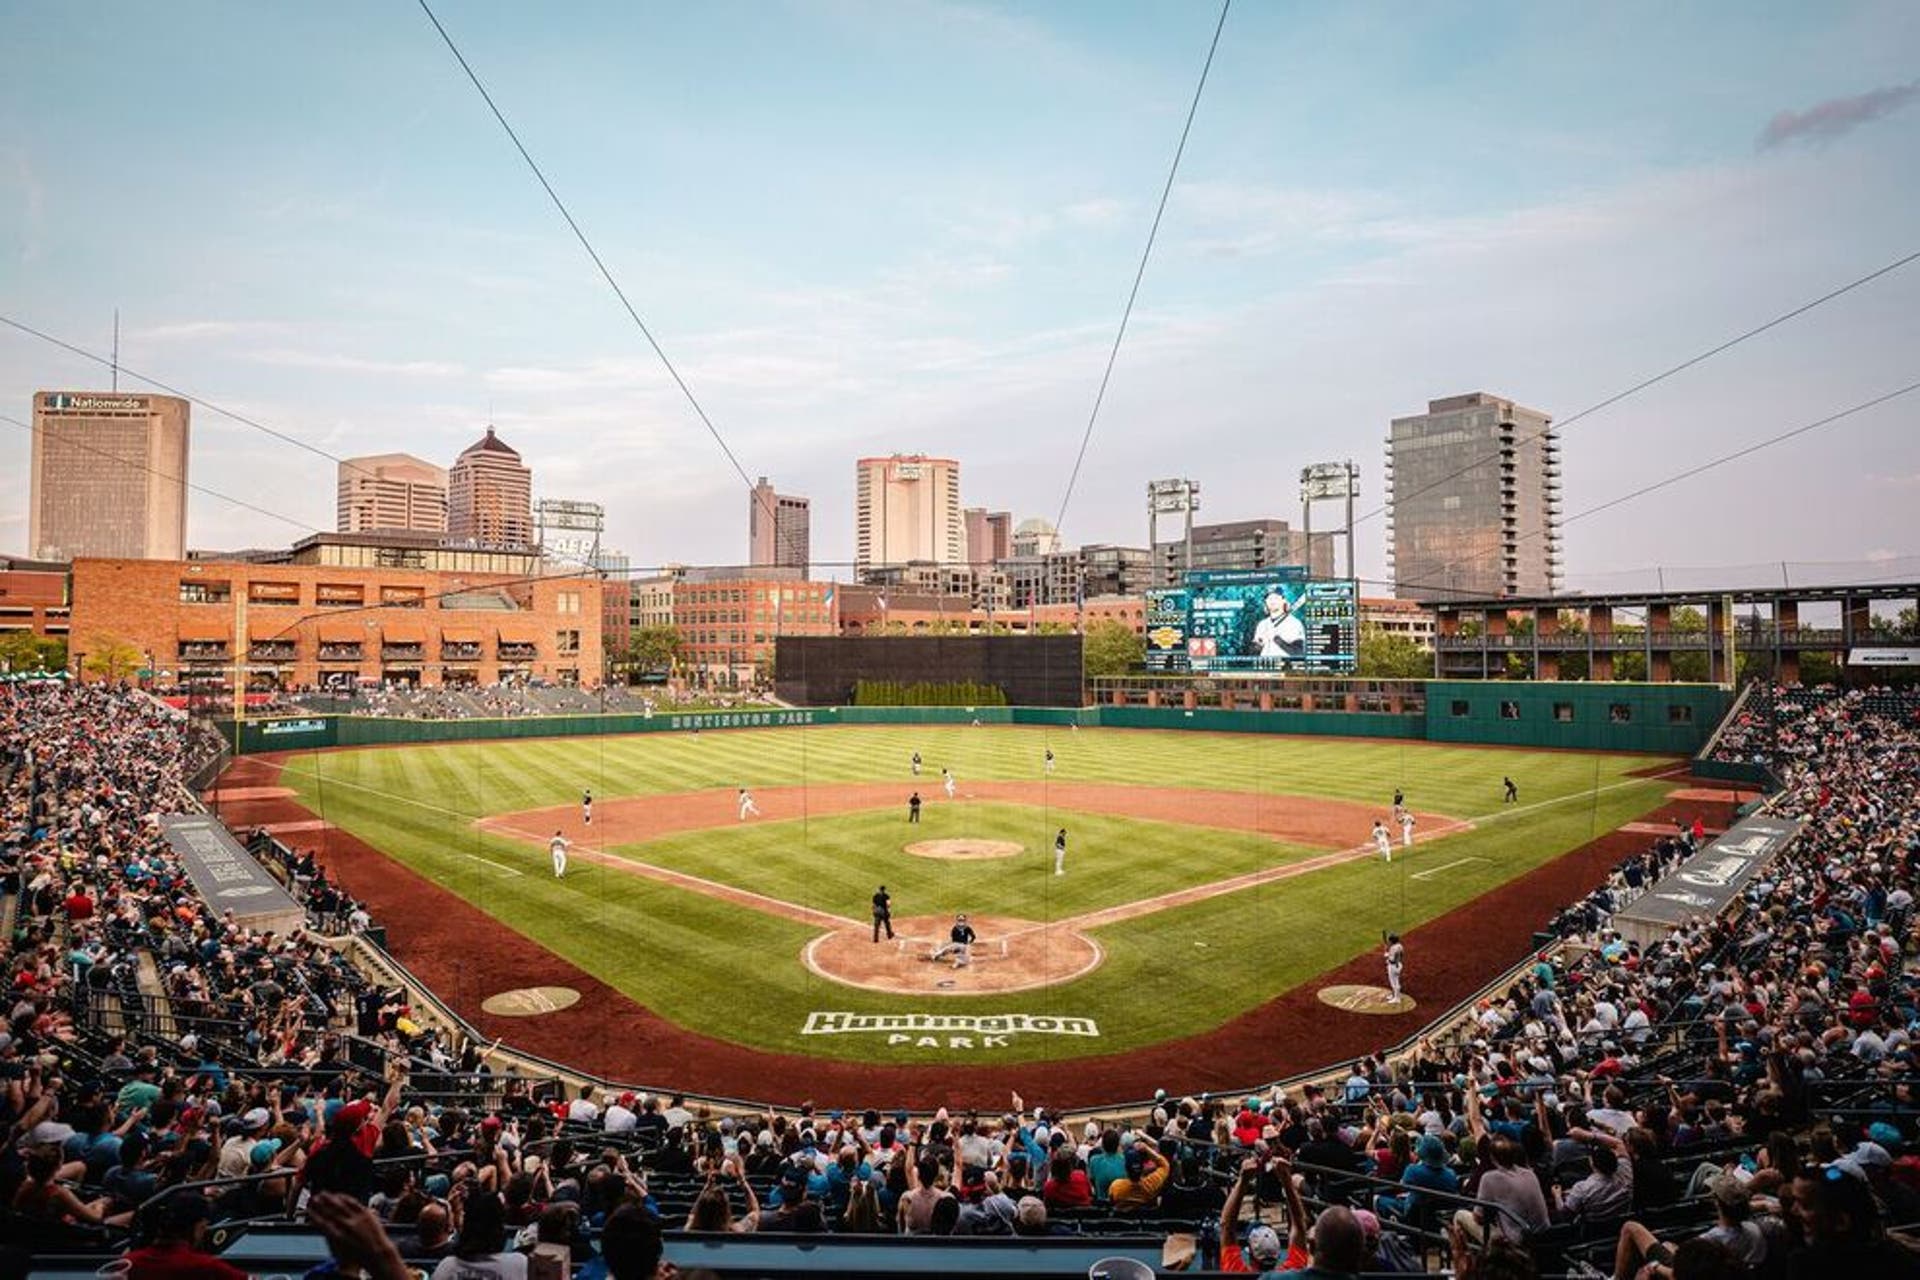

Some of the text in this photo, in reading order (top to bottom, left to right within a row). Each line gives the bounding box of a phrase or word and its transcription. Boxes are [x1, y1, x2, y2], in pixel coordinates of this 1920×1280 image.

[71, 396, 141, 409] Nationwide
[671, 711, 813, 728] HUNTINGTON PARK
[802, 1012, 1100, 1036] Huntington
[888, 1033, 1010, 1048] PARK
